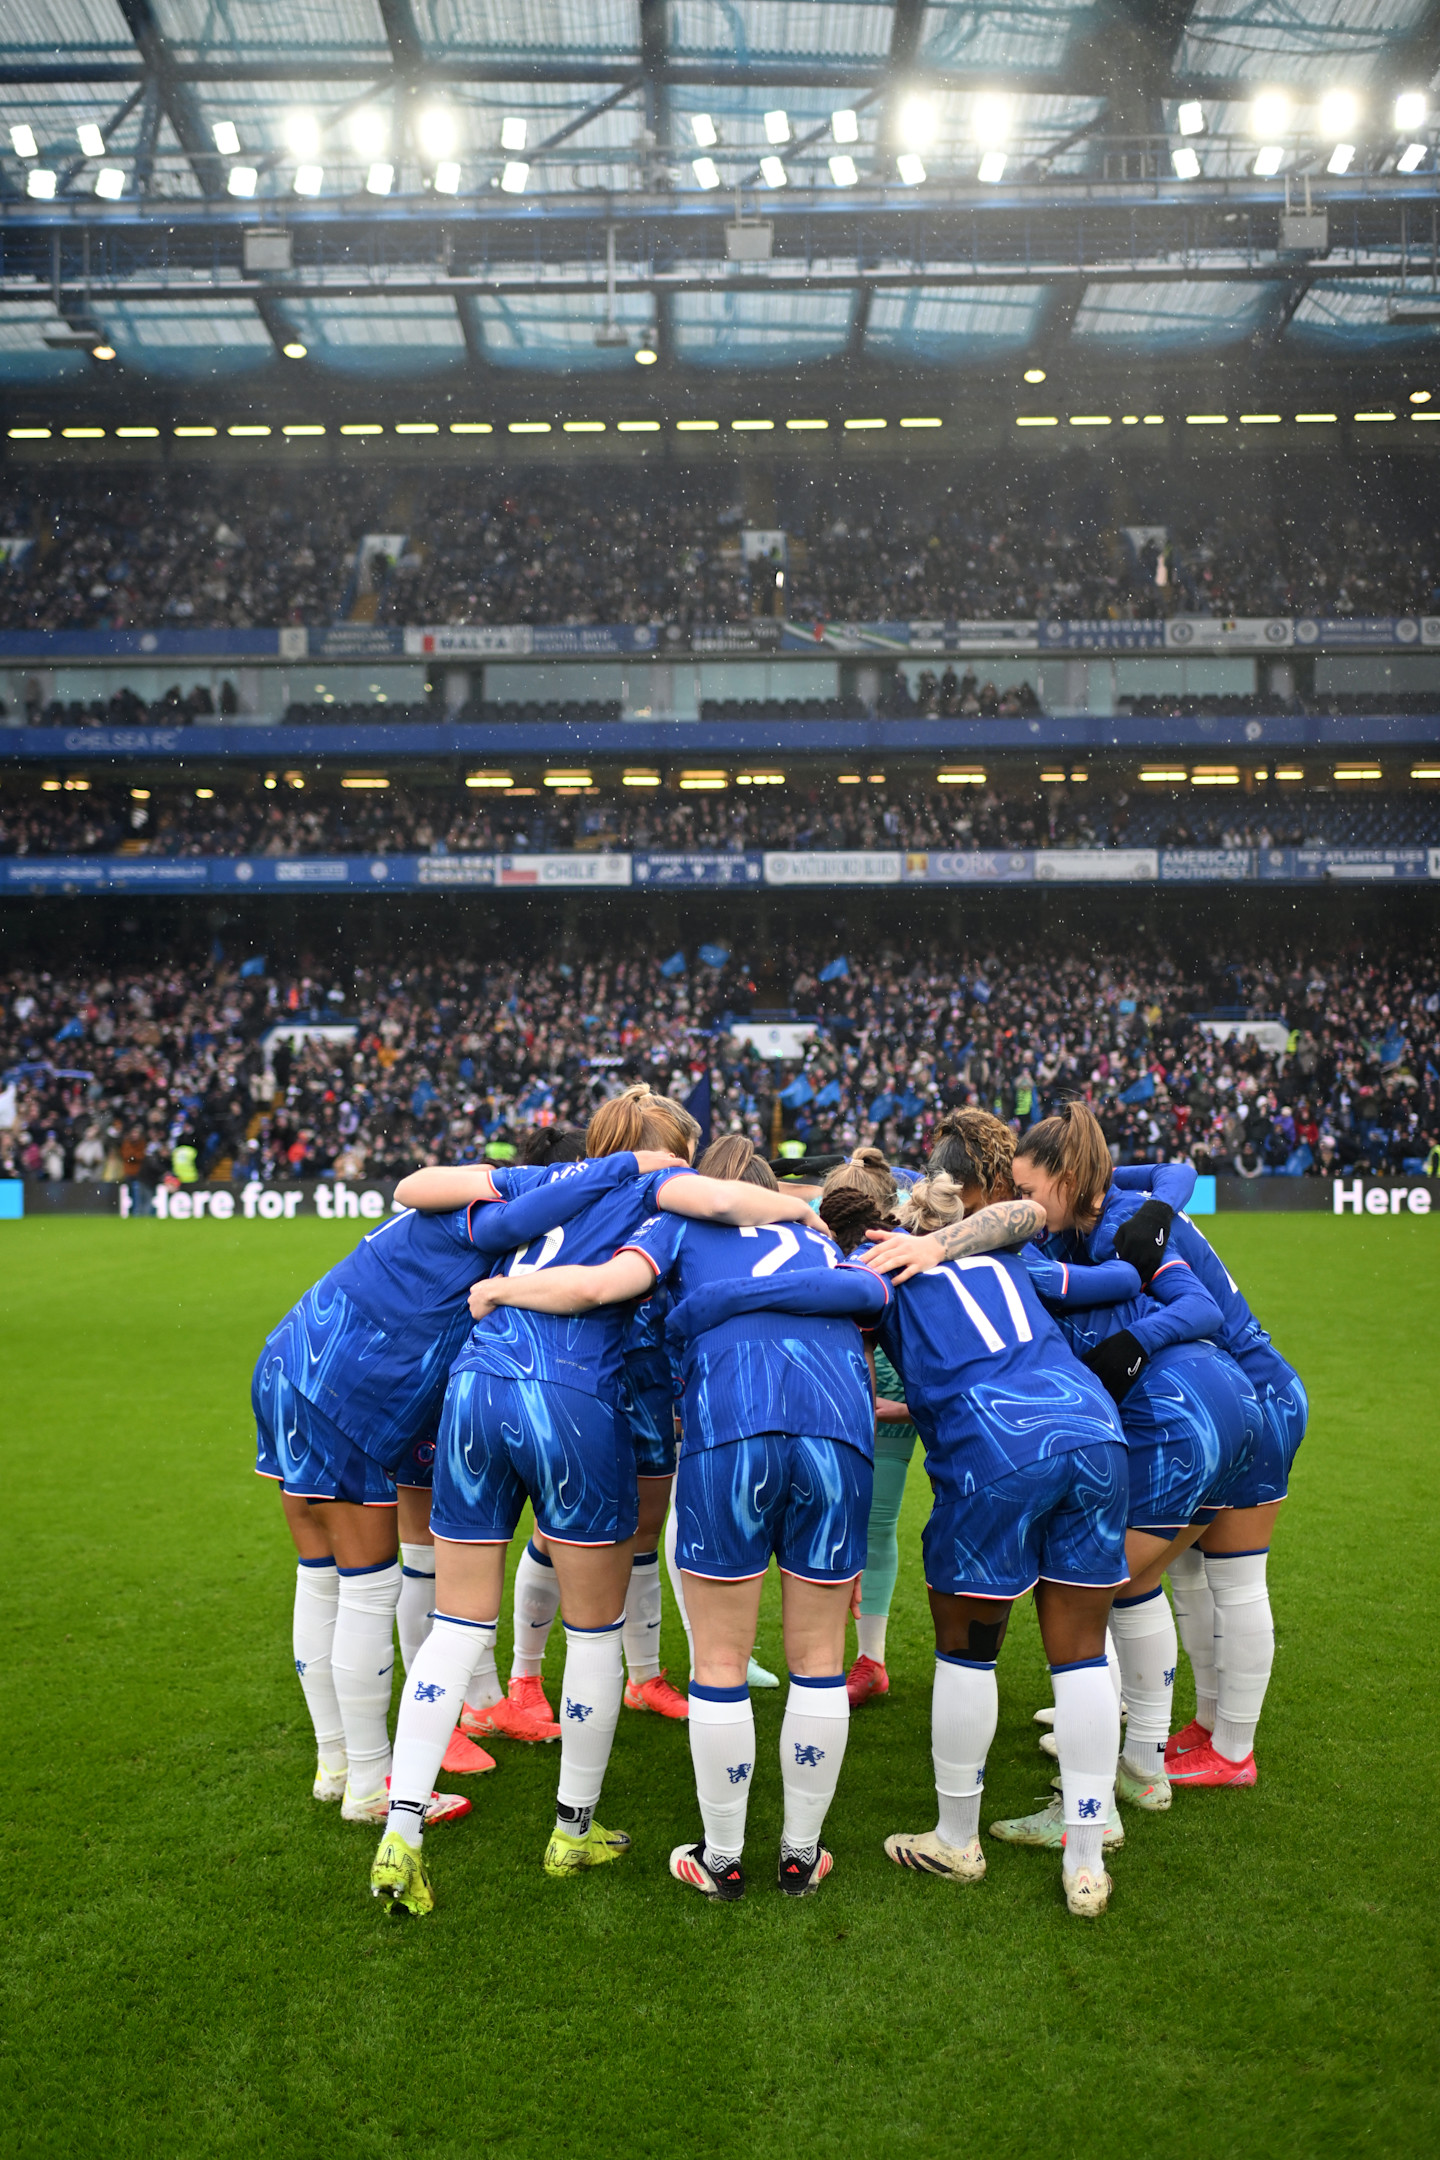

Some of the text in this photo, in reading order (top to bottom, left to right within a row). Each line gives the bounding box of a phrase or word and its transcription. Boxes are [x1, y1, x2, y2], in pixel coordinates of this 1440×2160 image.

[440, 636, 508, 650] MALTA
[65, 732, 178, 749] CHELSEA FC
[418, 856, 494, 869] CHELSEA
[936, 853, 998, 875] CORK
[1162, 850, 1249, 865] AMERICAN
[418, 870, 492, 883] CROATIA
[542, 862, 598, 880] CHILE
[1161, 867, 1249, 879] SOUTHWEST
[241, 1182, 303, 1219] for
[313, 1183, 384, 1219] the
[1333, 1179, 1432, 1215] Here
[922, 1255, 1033, 1353] 17
